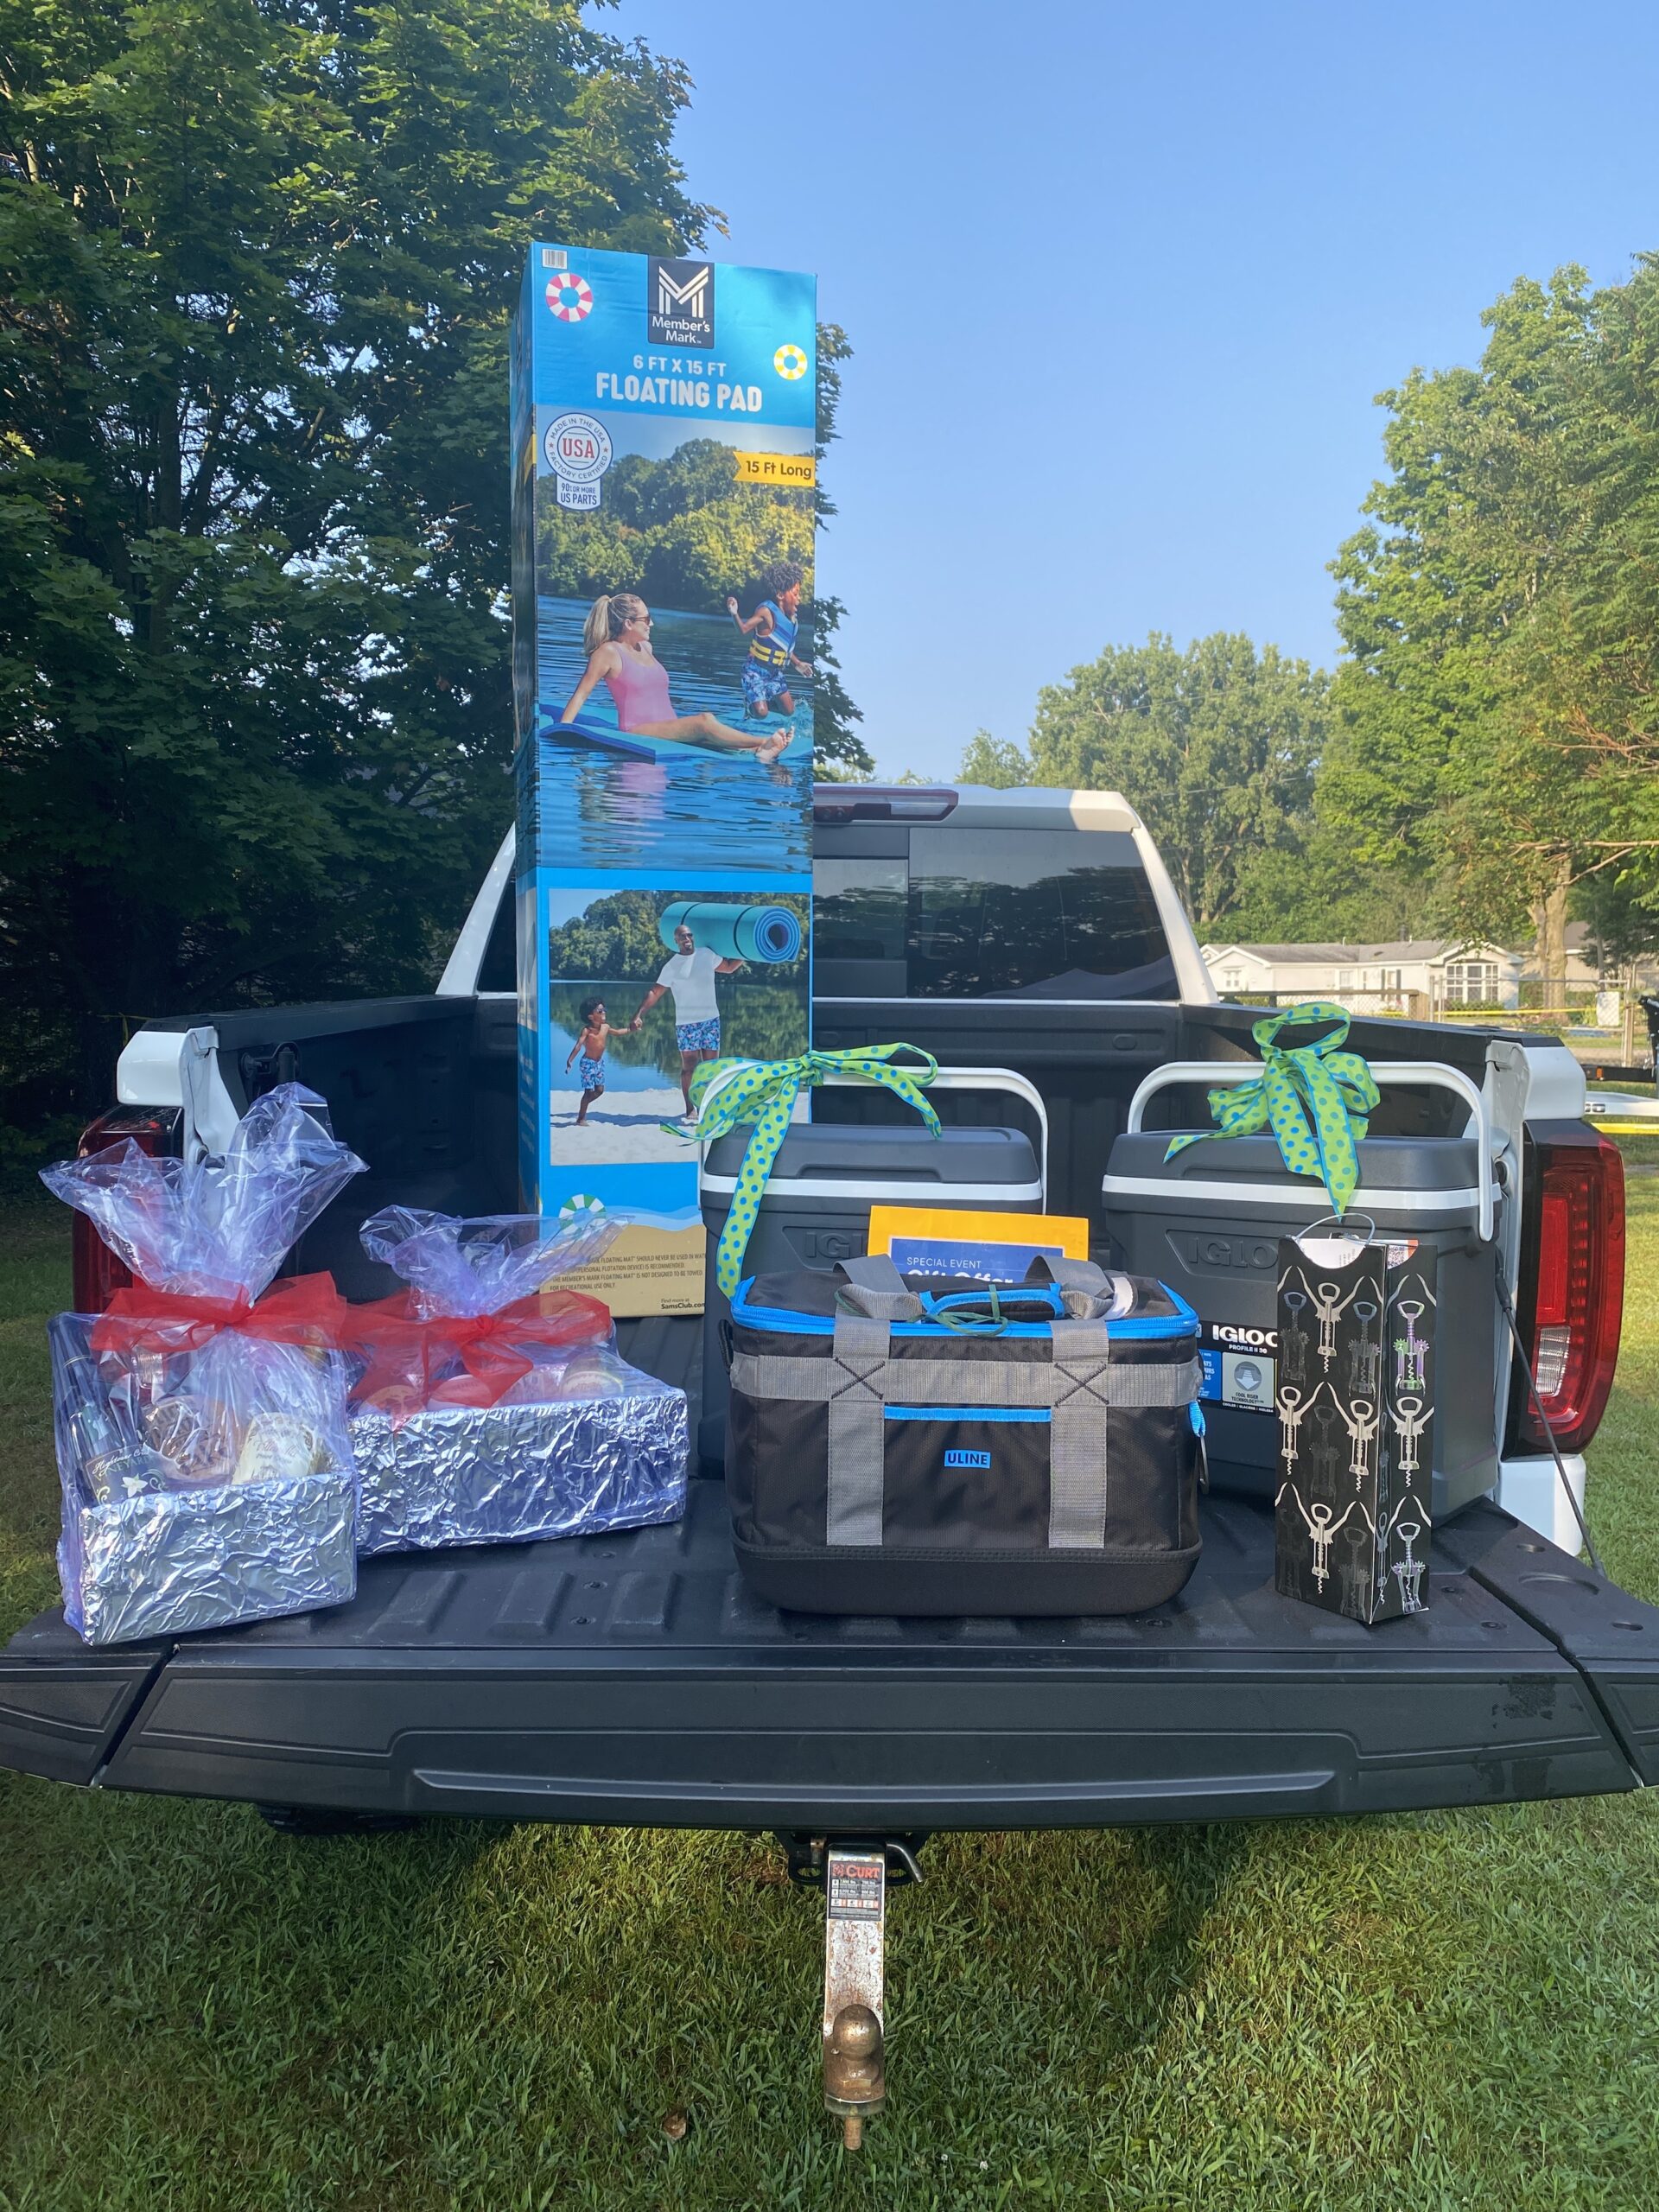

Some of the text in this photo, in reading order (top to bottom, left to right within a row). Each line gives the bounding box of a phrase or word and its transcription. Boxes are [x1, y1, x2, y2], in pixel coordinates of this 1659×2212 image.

[652, 316, 710, 333] Member's
[633, 354, 726, 378] 6 FT X 15 FT
[596, 372, 762, 412] FLOATING PAD
[550, 420, 568, 439] MADE
[579, 418, 594, 429] THE
[594, 428, 606, 443] USA
[563, 437, 594, 459] USA
[549, 451, 607, 480] FACTORY CERTIFIED
[746, 461, 811, 480] 15 Ft Long
[560, 493, 597, 505] US PARTS
[906, 1256, 982, 1268] SPECIAL EVENT
[1186, 1236, 1279, 1269] IGLO
[1229, 1344, 1254, 1352] PROFILE
[947, 1452, 988, 1465] ULINE
